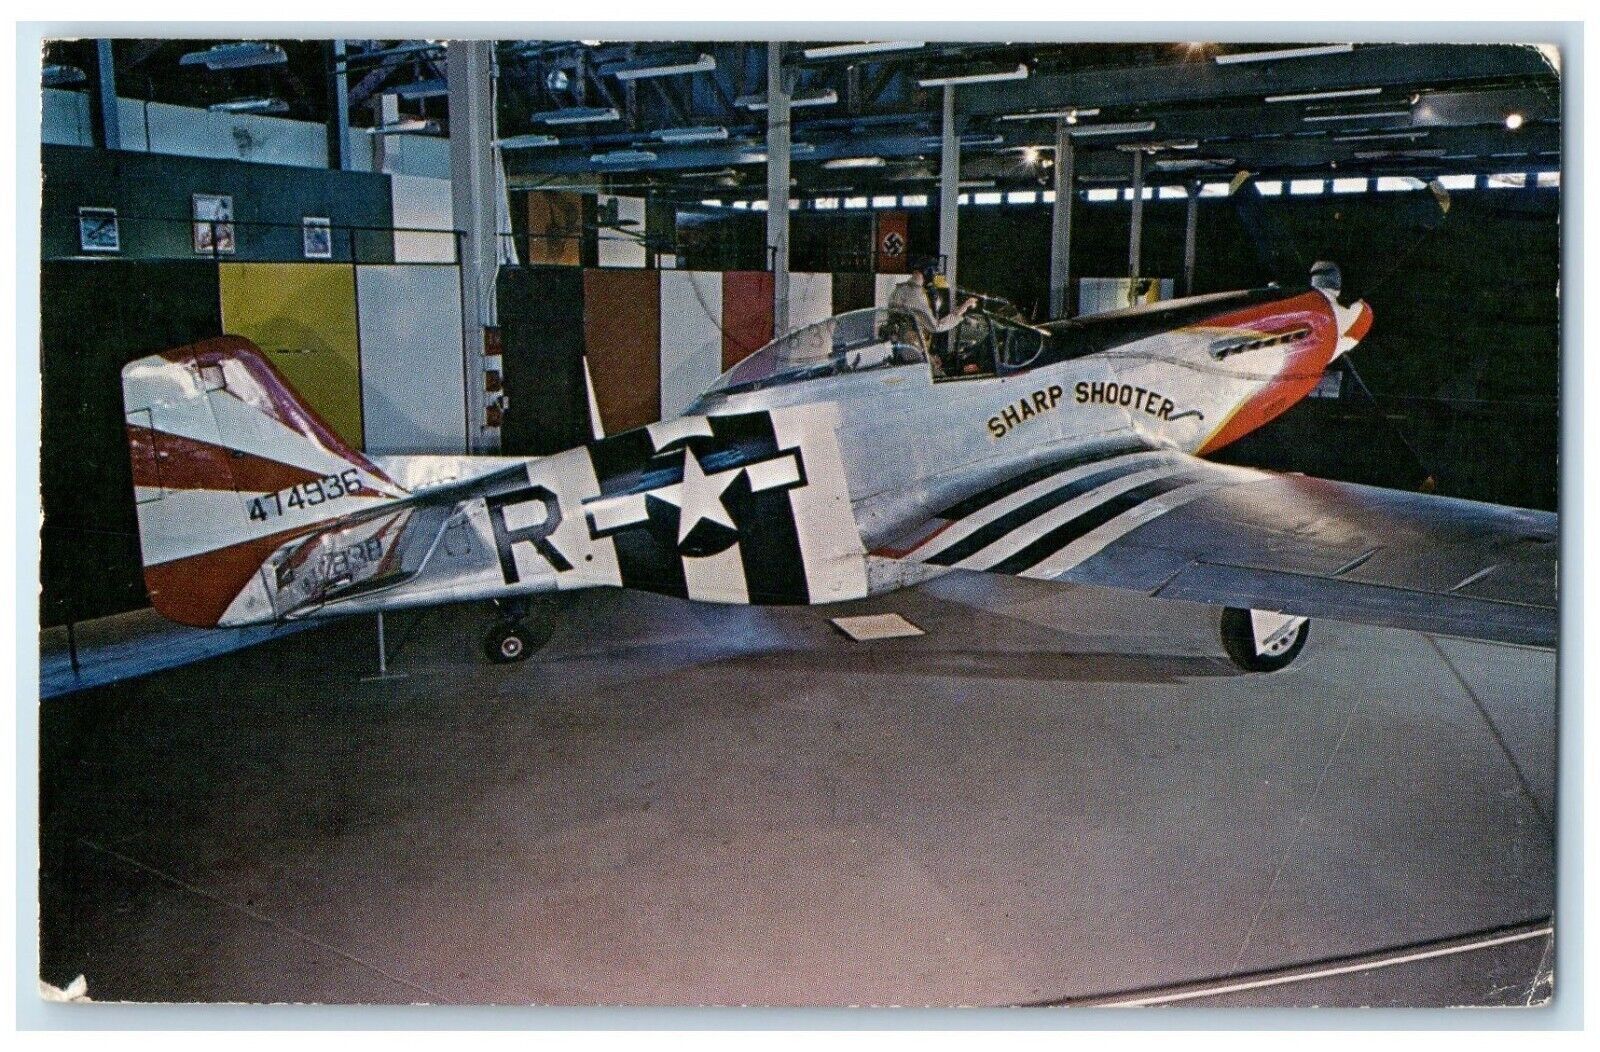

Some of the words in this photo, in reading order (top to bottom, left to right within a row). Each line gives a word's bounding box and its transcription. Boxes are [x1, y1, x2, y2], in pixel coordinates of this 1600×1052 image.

[987, 385, 1063, 438] SHARP
[1075, 381, 1174, 421] SHOOTER
[249, 468, 362, 521] 474936
[485, 484, 575, 585] R
